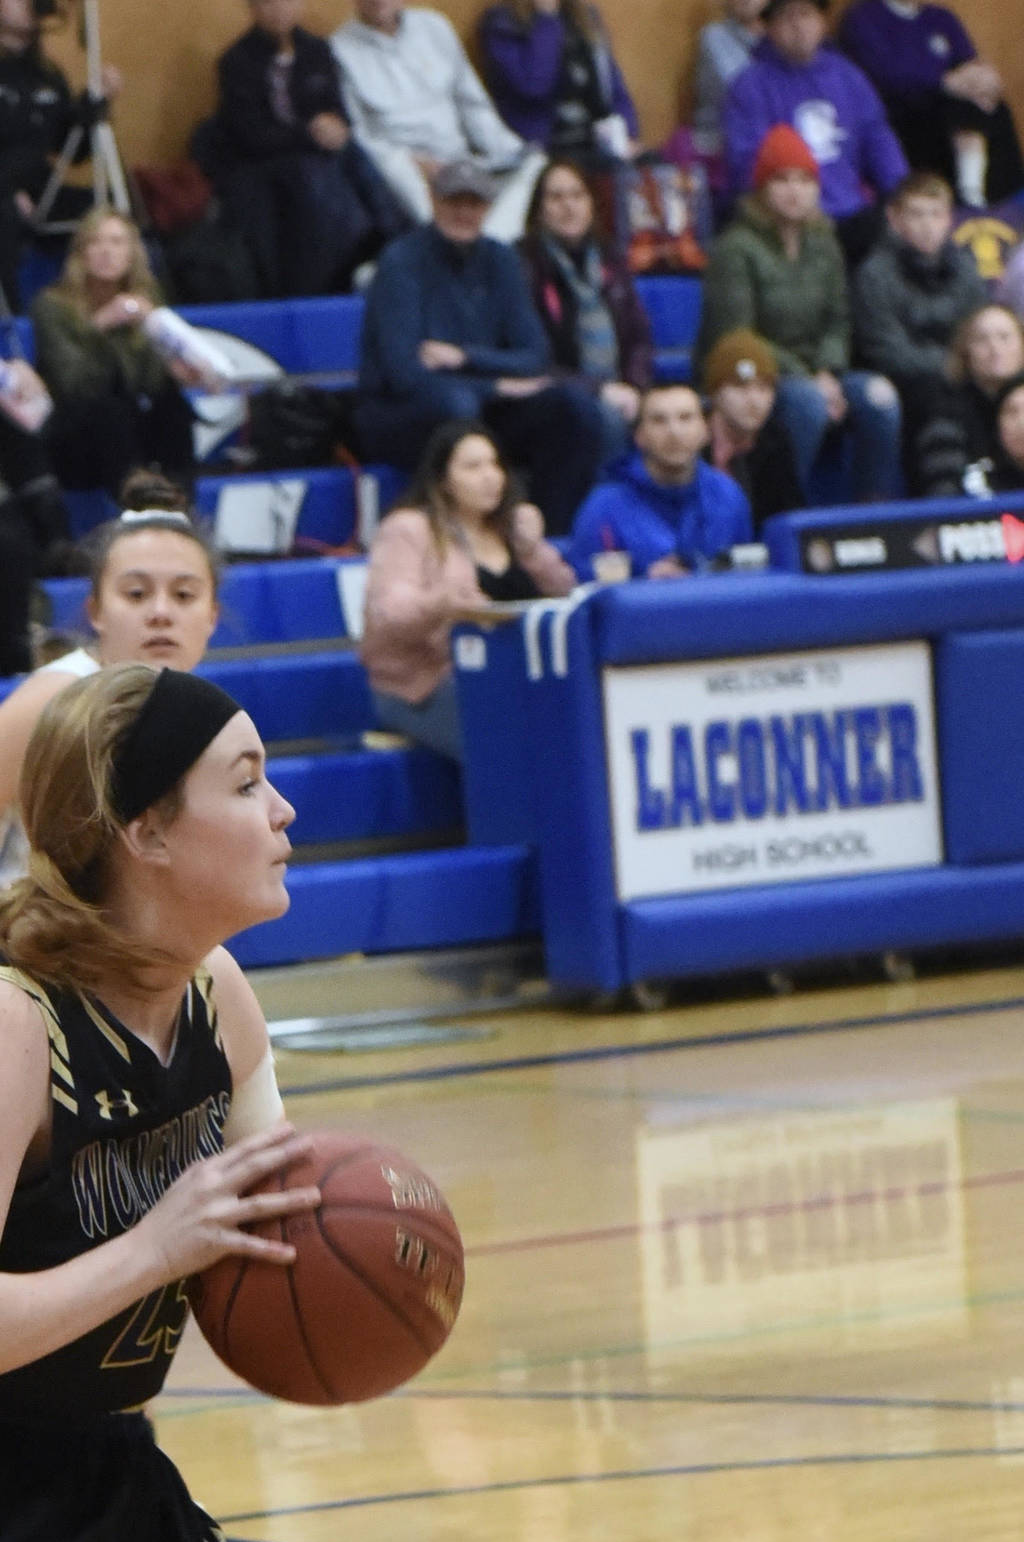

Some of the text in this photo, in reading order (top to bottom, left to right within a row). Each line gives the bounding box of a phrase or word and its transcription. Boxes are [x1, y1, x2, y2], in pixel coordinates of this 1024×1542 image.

[630, 701, 924, 834] LACONNER
[693, 832, 871, 870] HIGH SCHOOL
